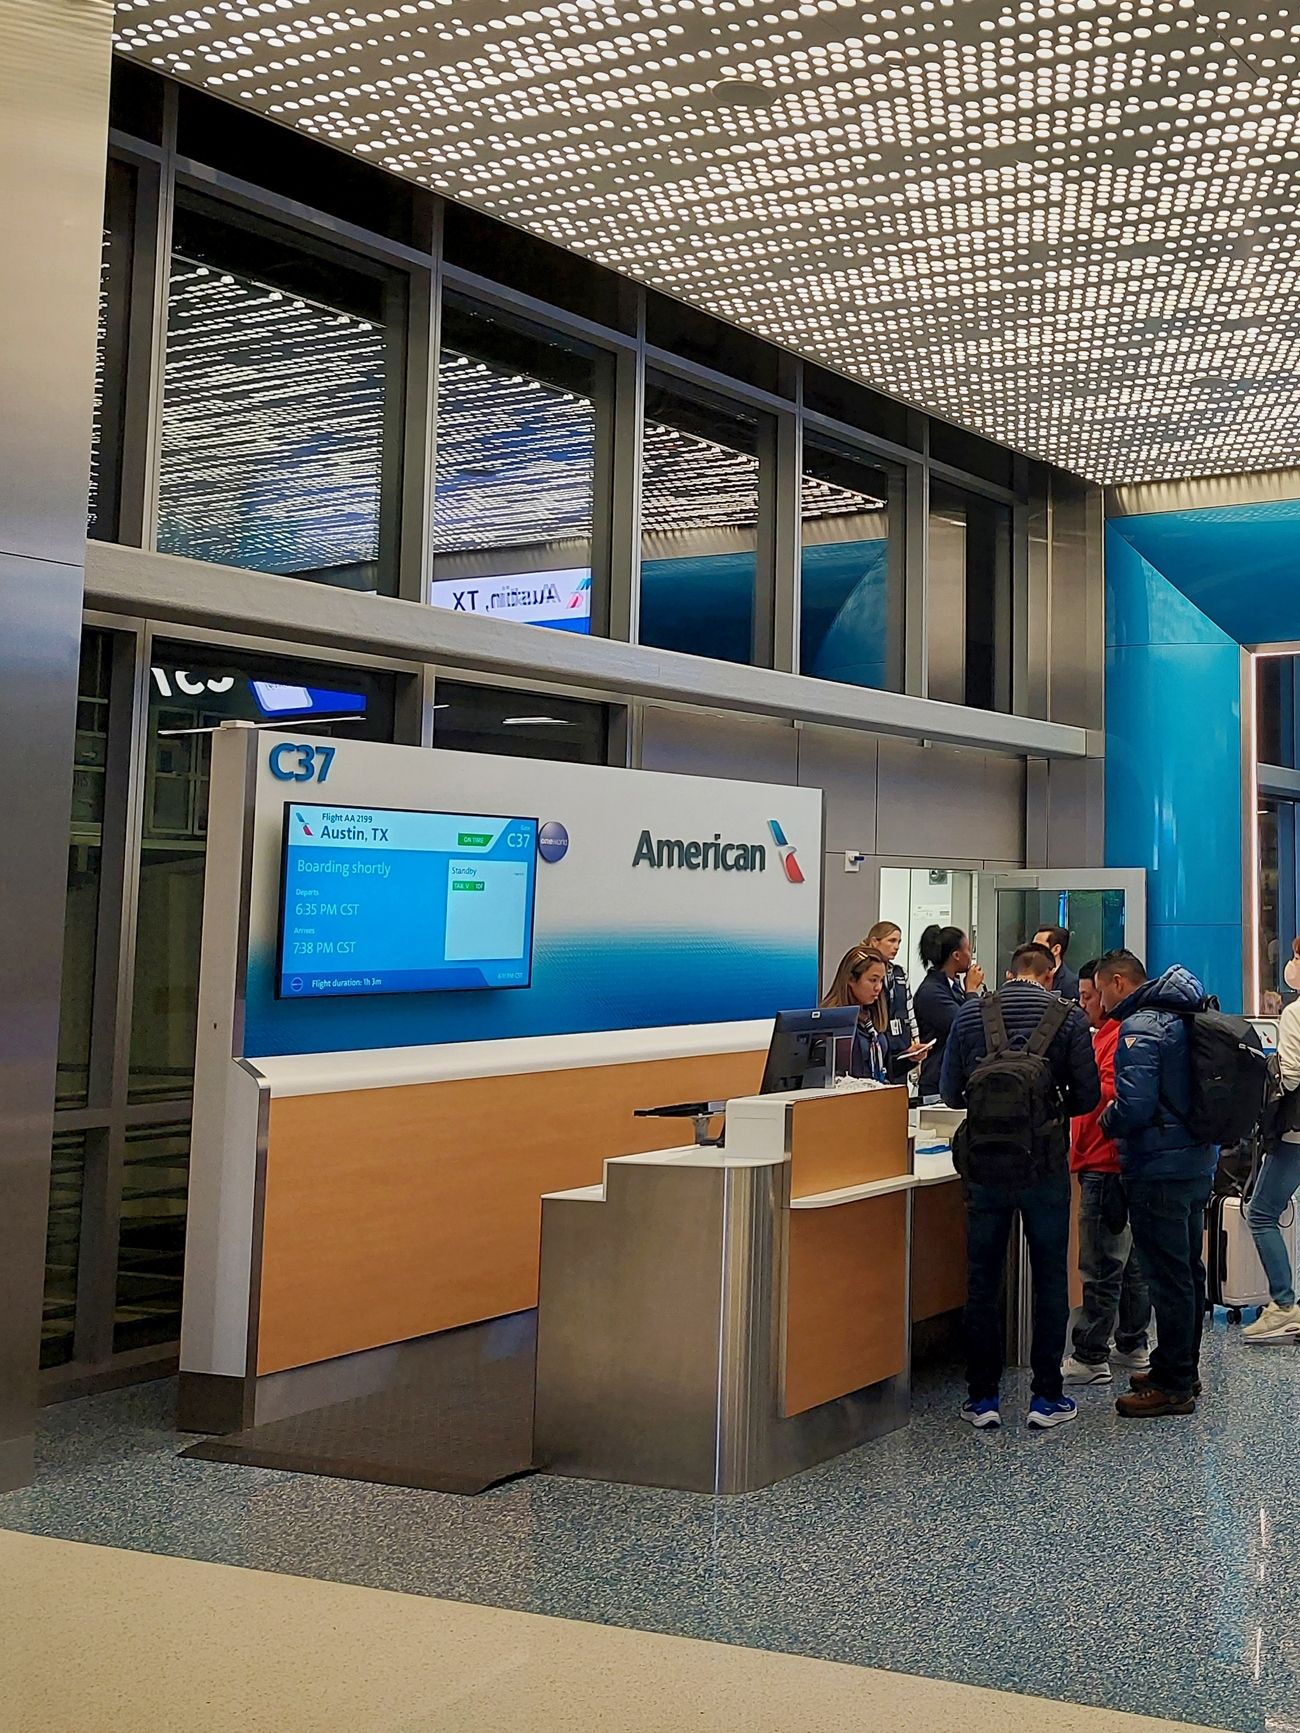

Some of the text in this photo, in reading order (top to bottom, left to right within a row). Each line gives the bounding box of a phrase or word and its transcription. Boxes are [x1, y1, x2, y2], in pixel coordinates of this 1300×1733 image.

[269, 742, 336, 784] C37
[322, 812, 373, 823] Flight AA 2199
[321, 826, 388, 842] Austin, TX
[507, 833, 530, 848] C37
[632, 830, 766, 872] American
[298, 860, 391, 878] Boarding shortly
[452, 867, 477, 876] Standby
[296, 889, 319, 897] Departs
[296, 904, 360, 915] 6:35 PM CST
[293, 942, 356, 954] 7:38 PM CST
[312, 980, 331, 989] Flight
[332, 979, 362, 987] duration:
